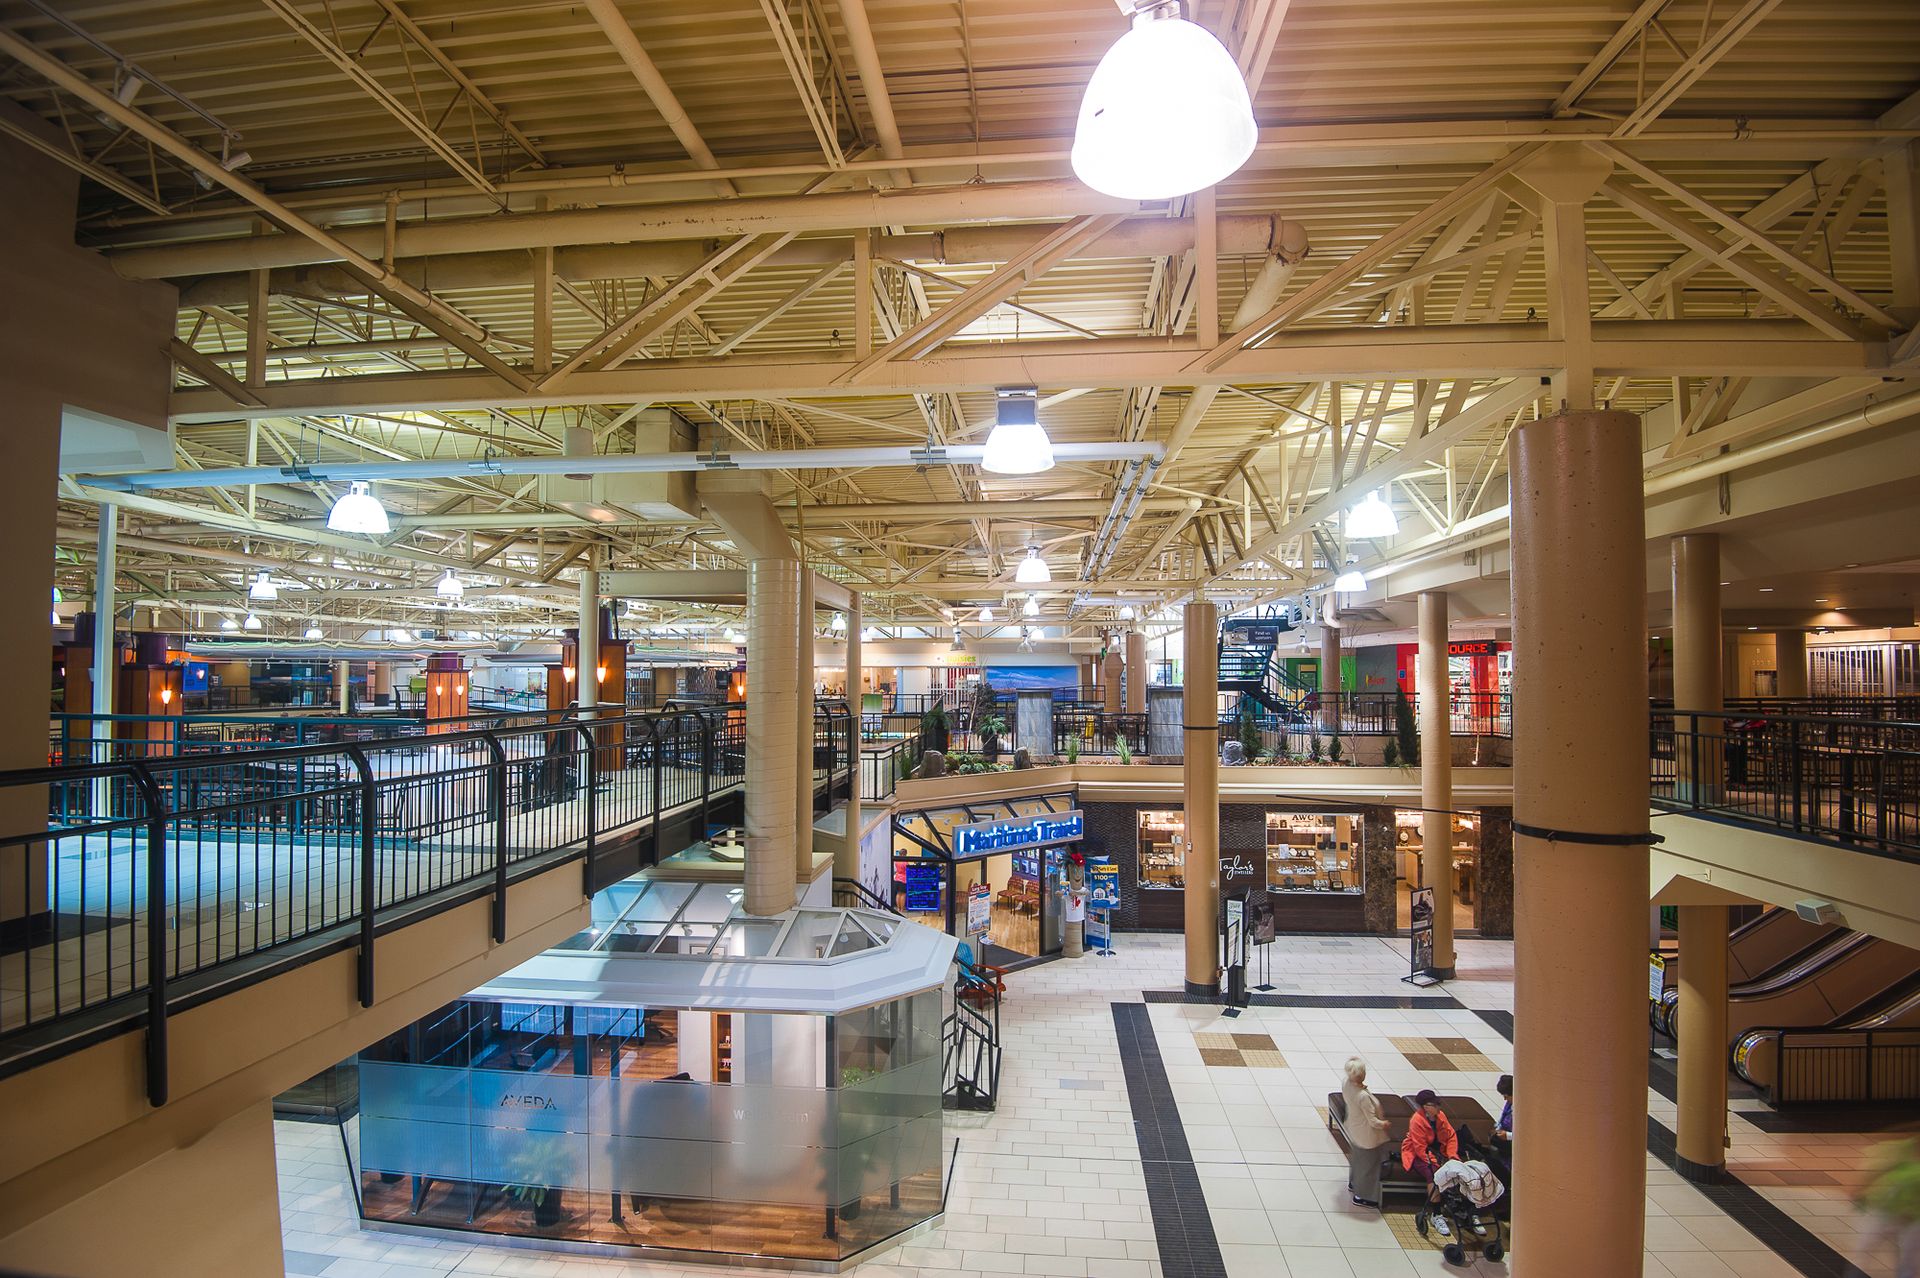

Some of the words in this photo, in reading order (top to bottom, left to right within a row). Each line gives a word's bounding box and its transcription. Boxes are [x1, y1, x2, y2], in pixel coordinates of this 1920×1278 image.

[1448, 643, 1488, 655] OURCE
[958, 823, 1038, 854] Maritime
[1034, 816, 1083, 842] Travel
[500, 1094, 557, 1110] AVEDA
